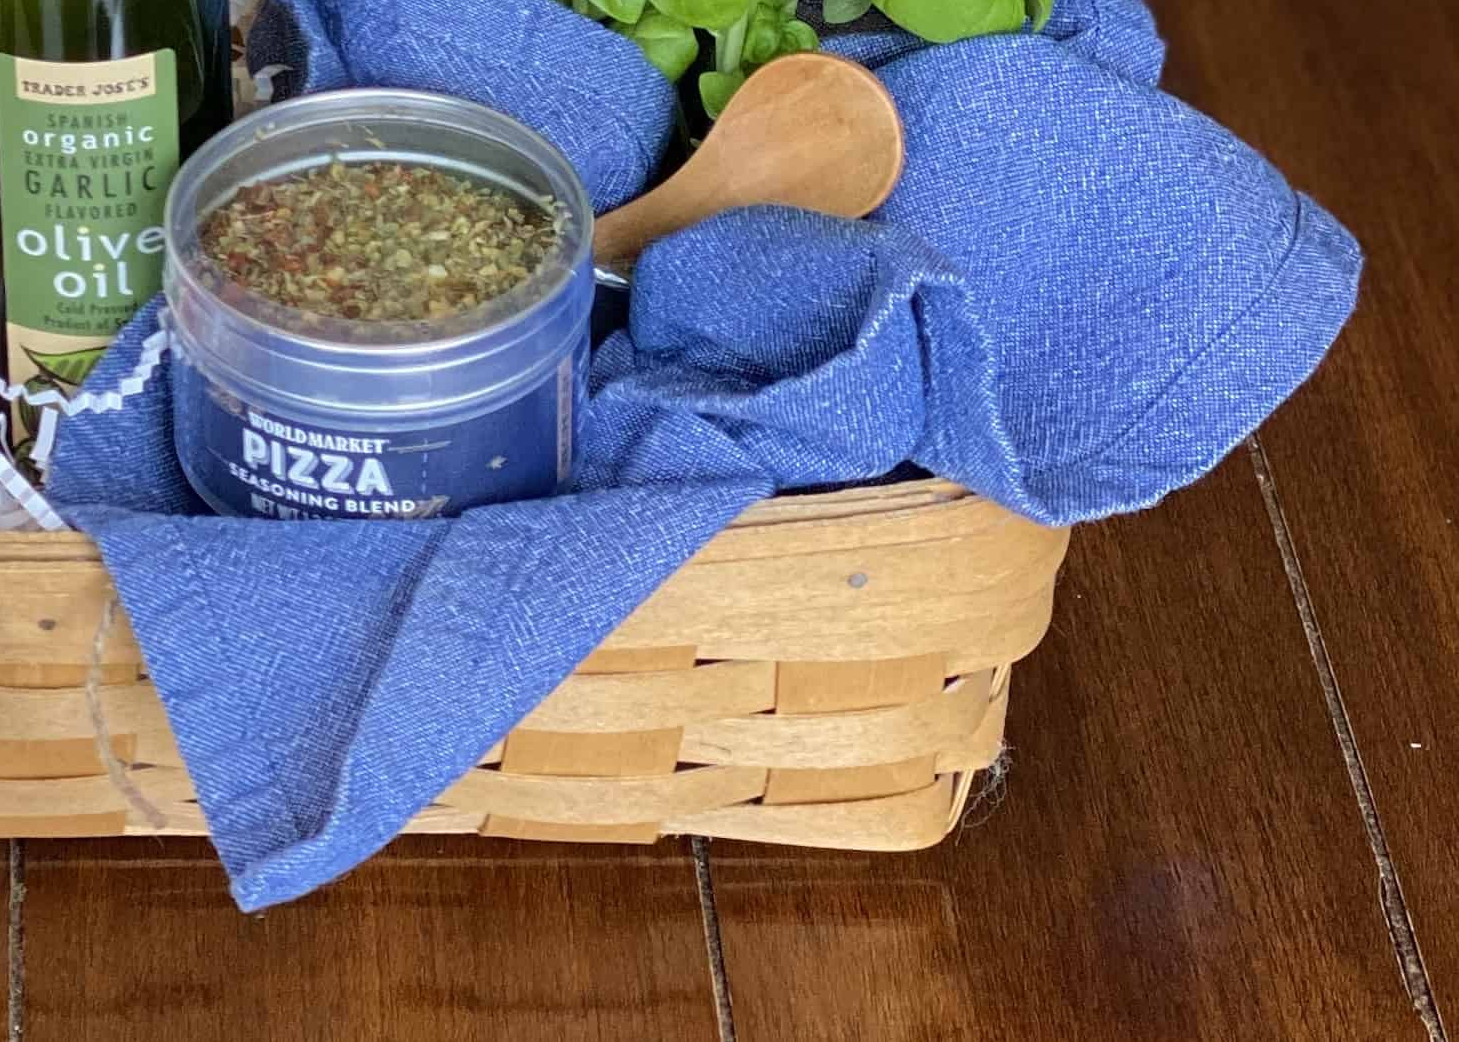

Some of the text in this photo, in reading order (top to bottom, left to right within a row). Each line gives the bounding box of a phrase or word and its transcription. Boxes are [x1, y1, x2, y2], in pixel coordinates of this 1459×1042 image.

[21, 76, 150, 97] TRADER JOSE'S
[46, 113, 128, 129] SPANISH
[22, 125, 155, 155] organic
[24, 147, 154, 169] EXTRA VIRGIN
[24, 165, 158, 200] GARLIC
[44, 202, 138, 220] FLAVORED
[16, 223, 166, 261] olive
[52, 261, 134, 298] oil
[247, 411, 387, 455] WORLD MARKET
[242, 427, 394, 497] PIZZA
[228, 461, 416, 514] SEASONING BLEND
